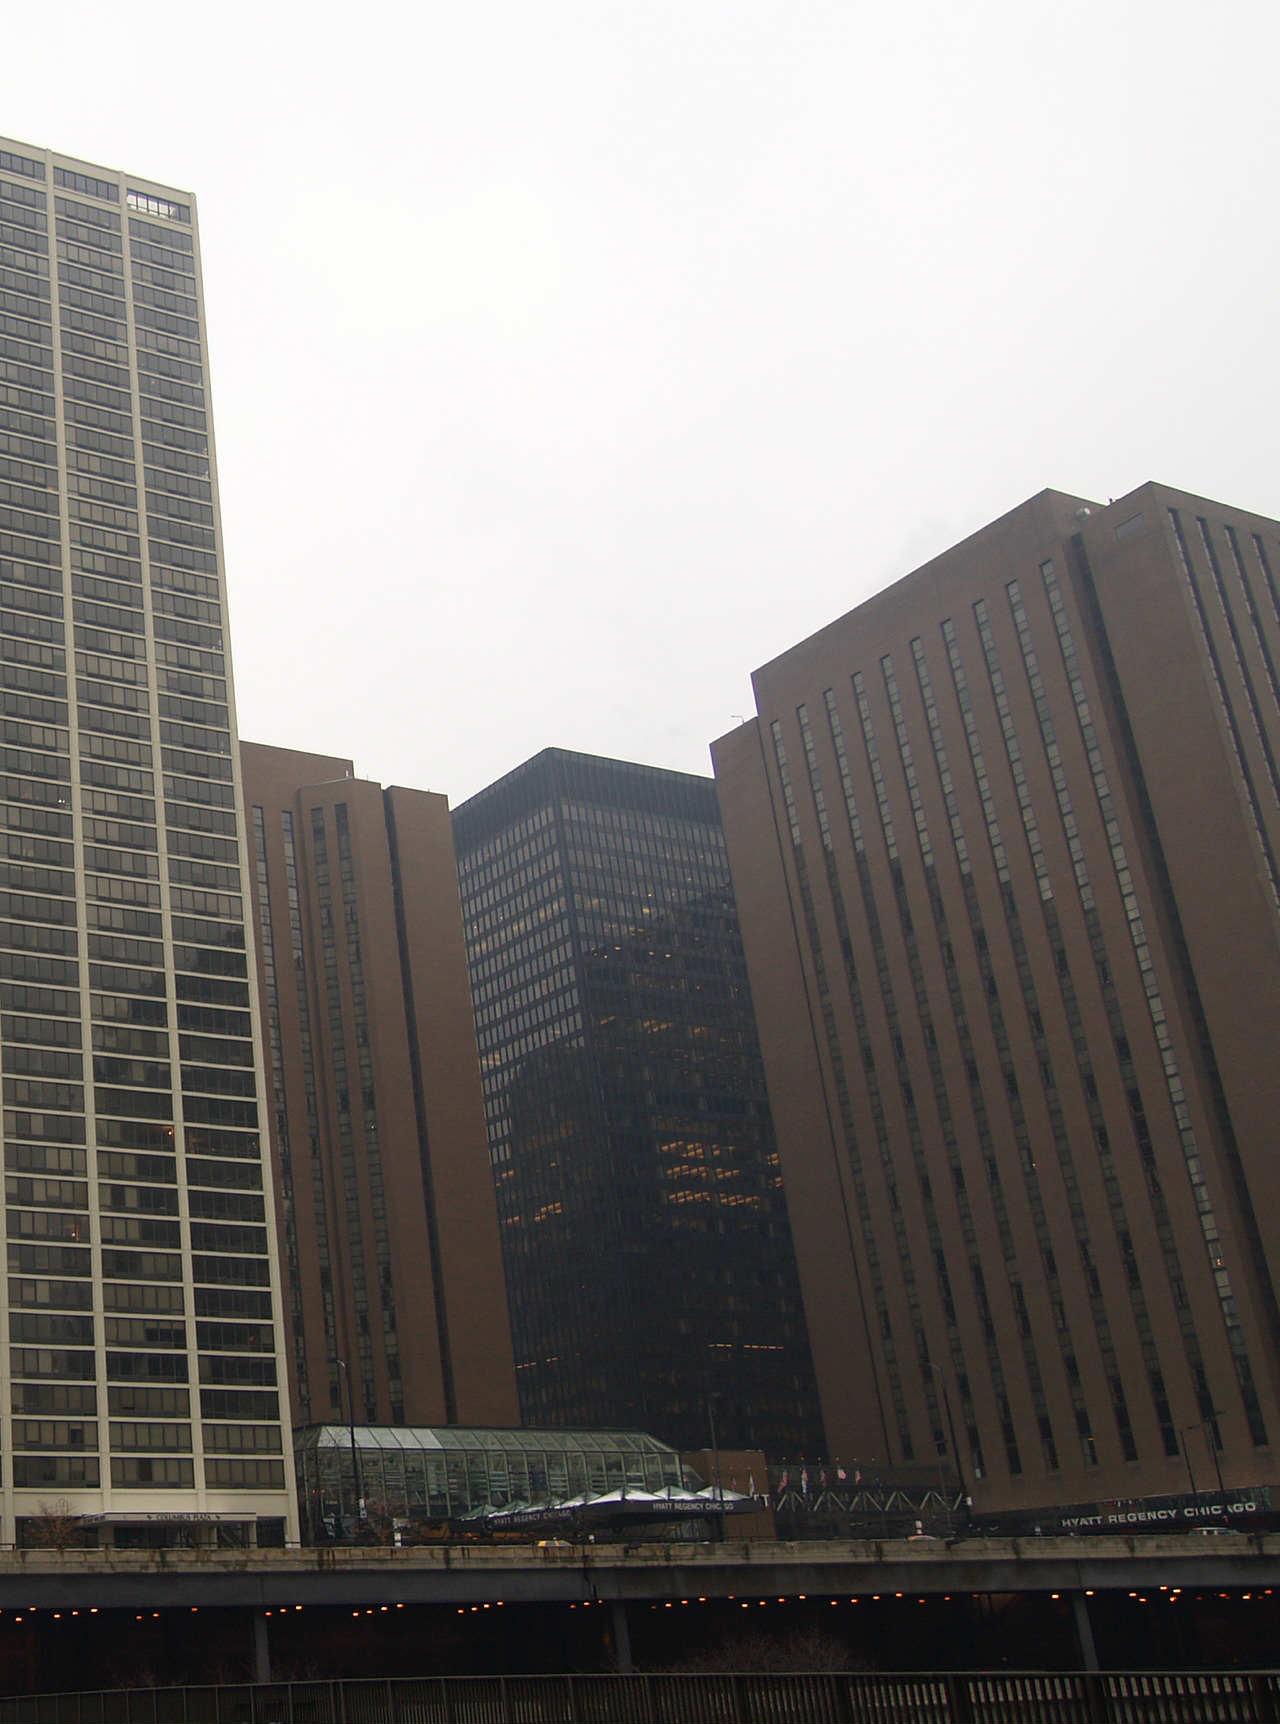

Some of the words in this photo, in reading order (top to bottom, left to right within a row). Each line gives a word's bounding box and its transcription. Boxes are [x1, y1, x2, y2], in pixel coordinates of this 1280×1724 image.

[653, 1502, 672, 1511] HYATT
[673, 1502, 703, 1511] REGENCY
[704, 1502, 735, 1511] CHICGO
[1061, 1516, 1103, 1528] HYATT
[1108, 1509, 1177, 1524] REGENCY
